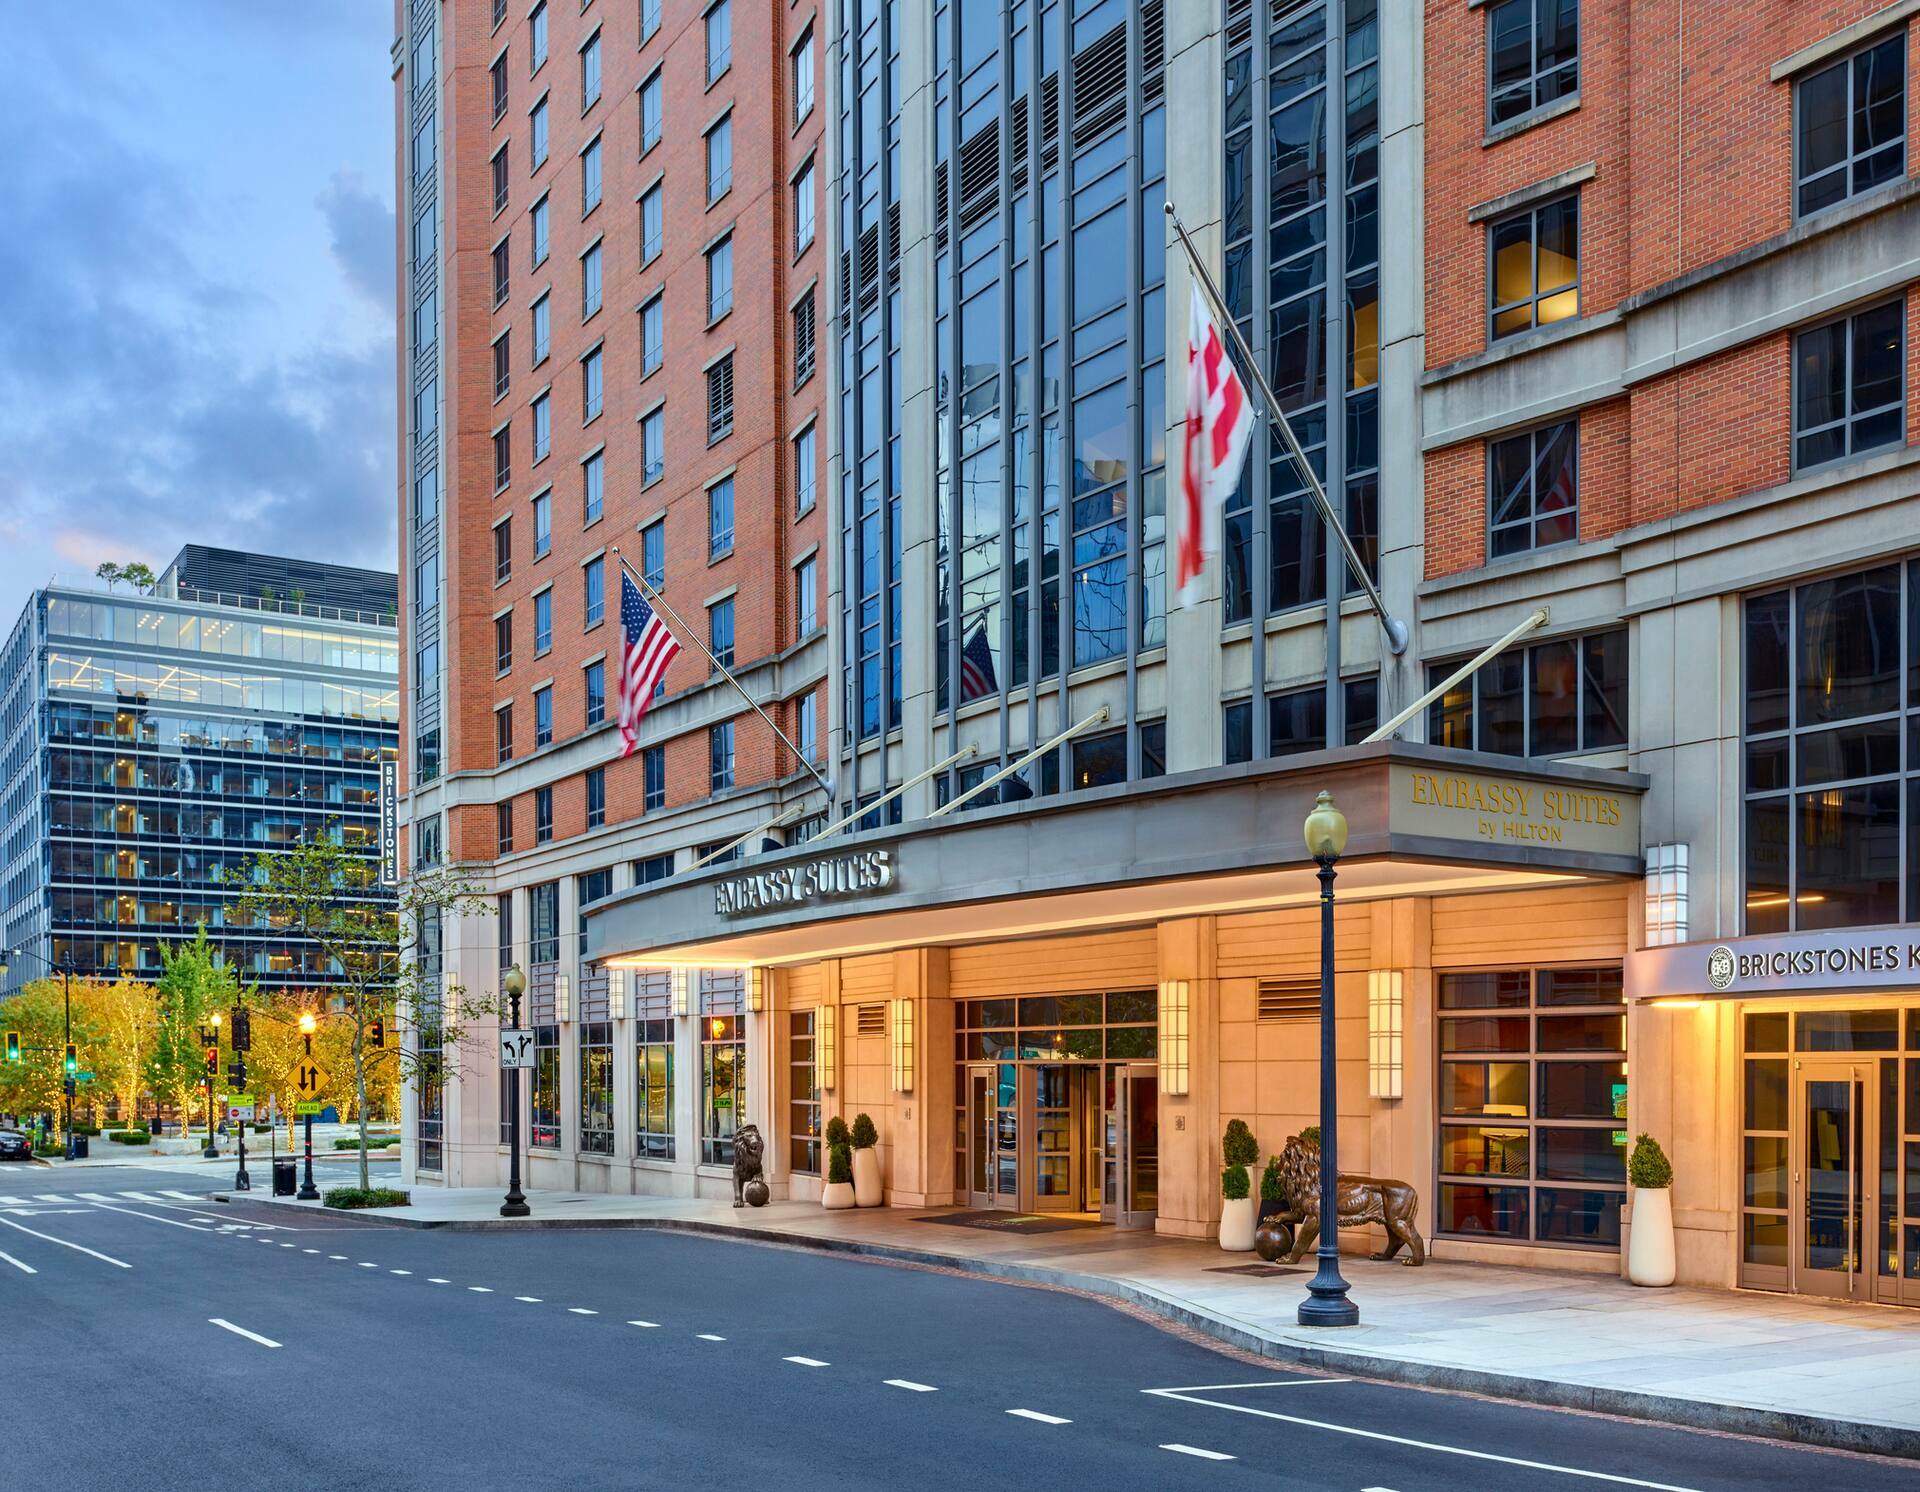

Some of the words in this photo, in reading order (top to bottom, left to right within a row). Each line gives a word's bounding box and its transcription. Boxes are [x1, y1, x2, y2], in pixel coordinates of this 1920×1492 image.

[1412, 773, 1532, 816] EMBASSY
[1544, 791, 1622, 825] SUITES
[386, 766, 394, 878] BRICKSTONES
[1479, 817, 1496, 839] by
[1504, 821, 1562, 842] HILTON
[714, 867, 803, 915] EMBASSY
[805, 851, 890, 896] SUITES
[1740, 944, 1901, 977] BRICKSTONES
[299, 1104, 318, 1112] AHEAD
